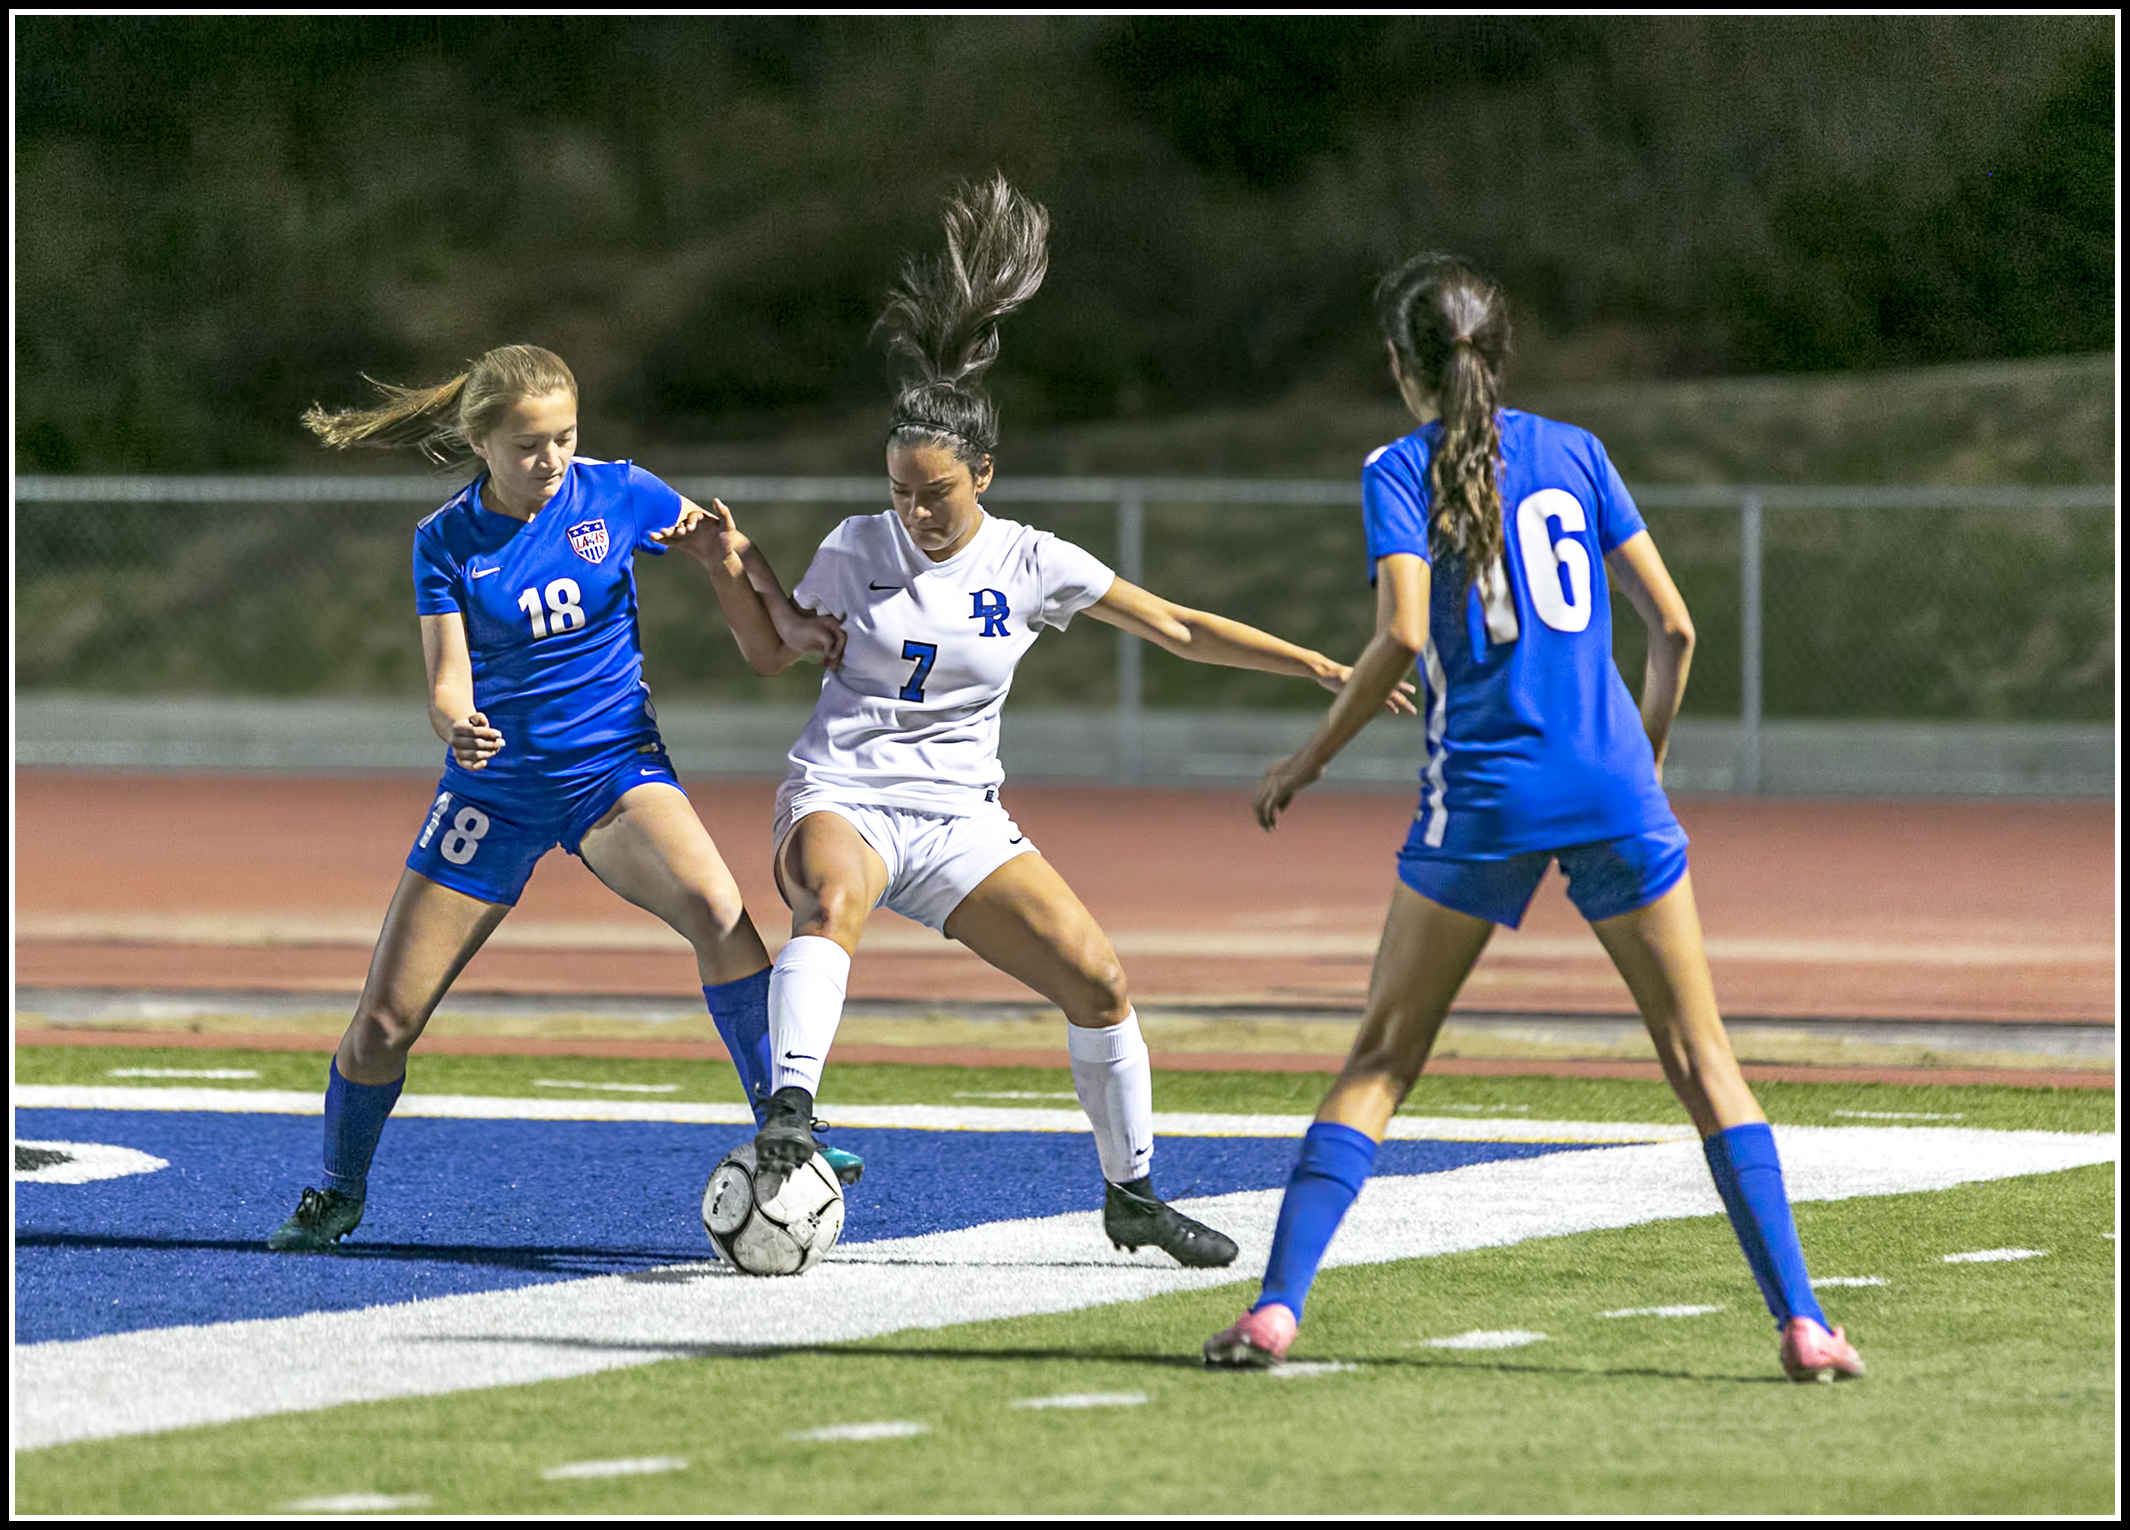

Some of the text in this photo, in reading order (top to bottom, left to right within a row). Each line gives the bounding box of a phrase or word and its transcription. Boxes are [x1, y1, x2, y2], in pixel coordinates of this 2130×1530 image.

[518, 577, 586, 639] 18
[899, 639, 938, 704] 7
[419, 791, 490, 865] 18
